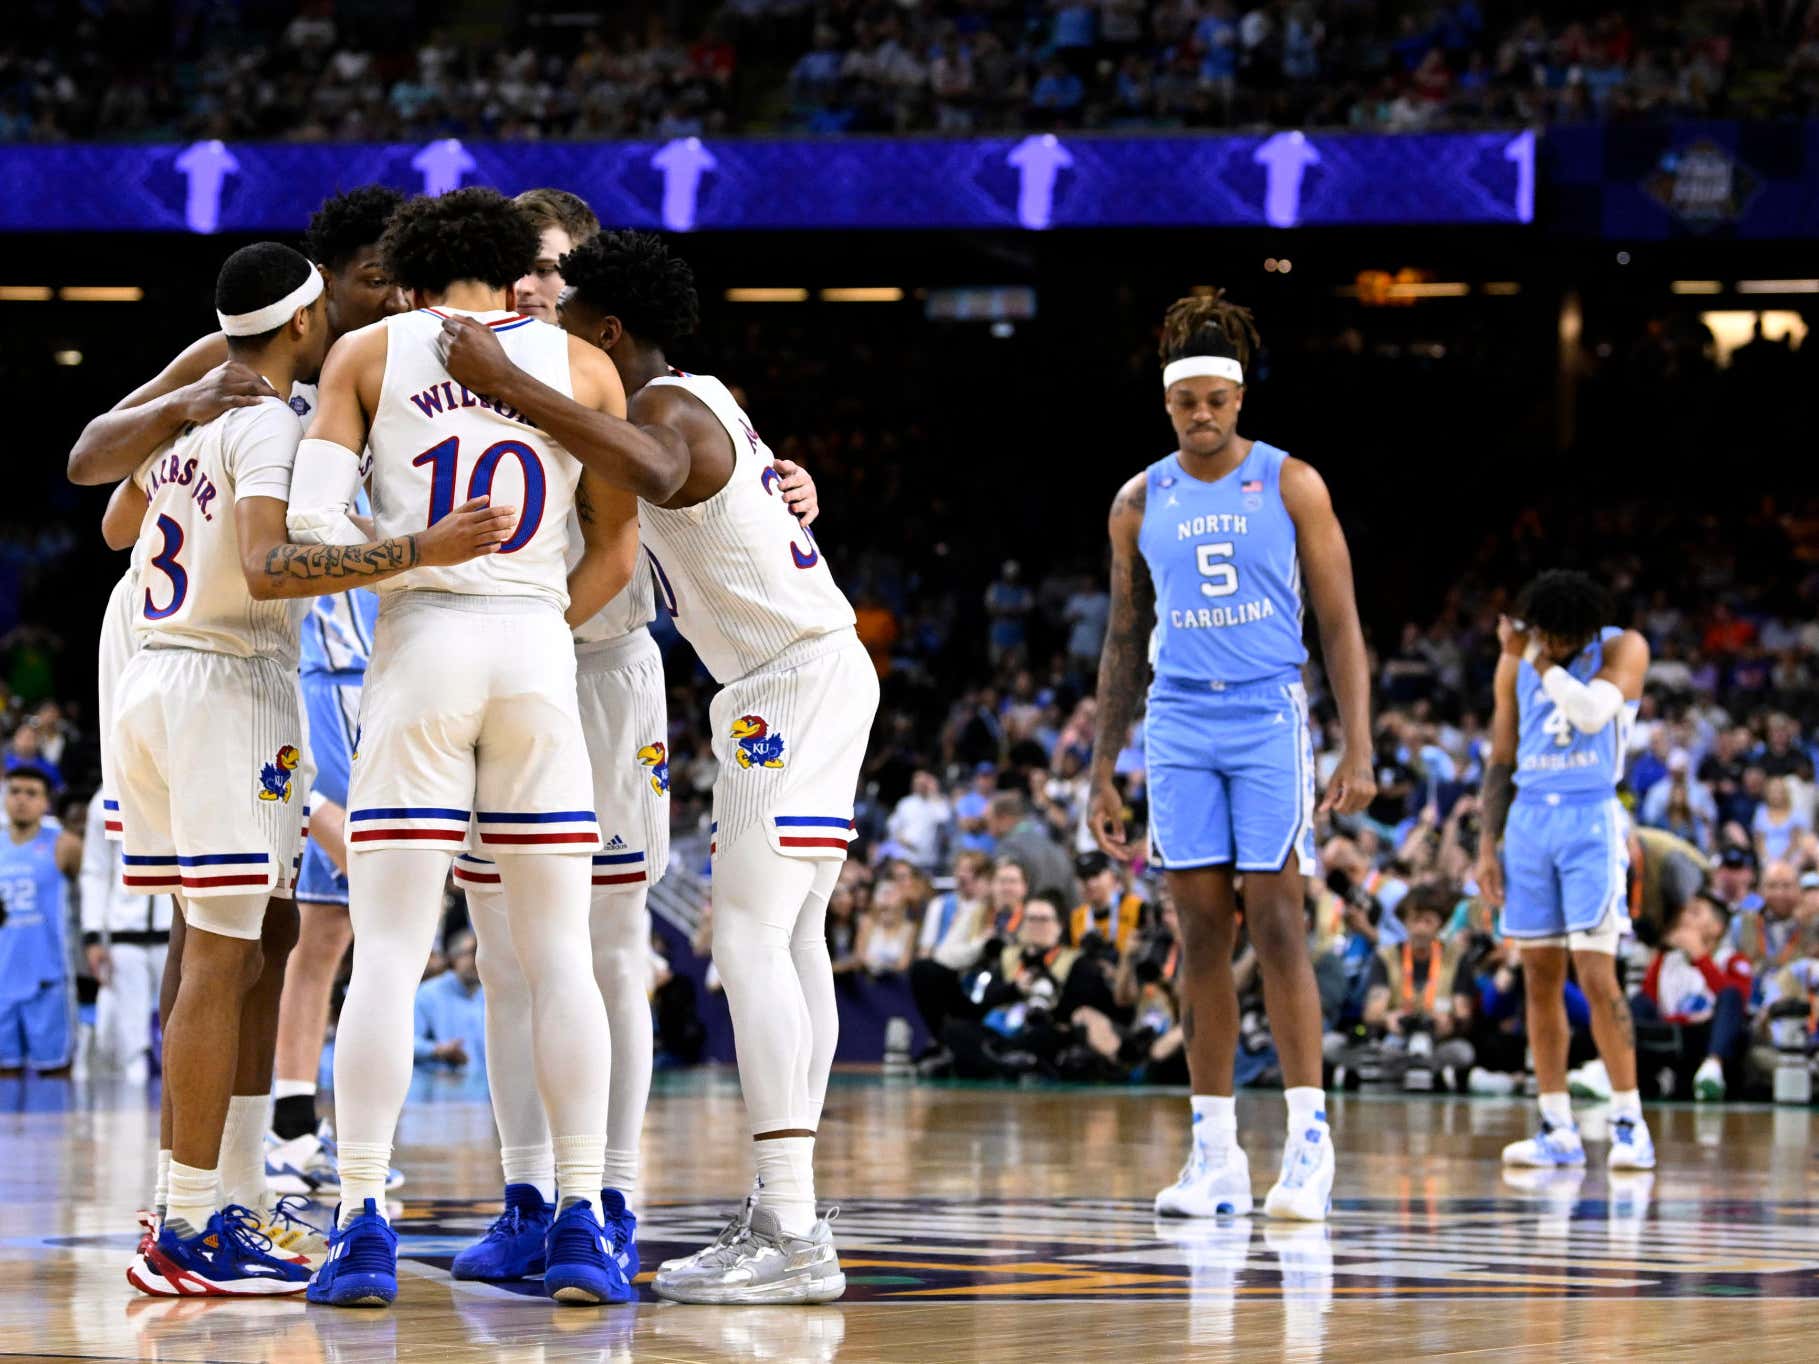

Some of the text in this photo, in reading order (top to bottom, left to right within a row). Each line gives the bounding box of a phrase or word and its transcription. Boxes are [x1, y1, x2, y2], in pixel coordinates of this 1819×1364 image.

[412, 435, 547, 554] 10
[1177, 513, 1248, 541] NORTH
[143, 512, 188, 620] 3
[1195, 541, 1239, 597] 5
[1171, 597, 1274, 629] CAROLINA
[1542, 704, 1573, 748] 4
[753, 743, 769, 754] KU
